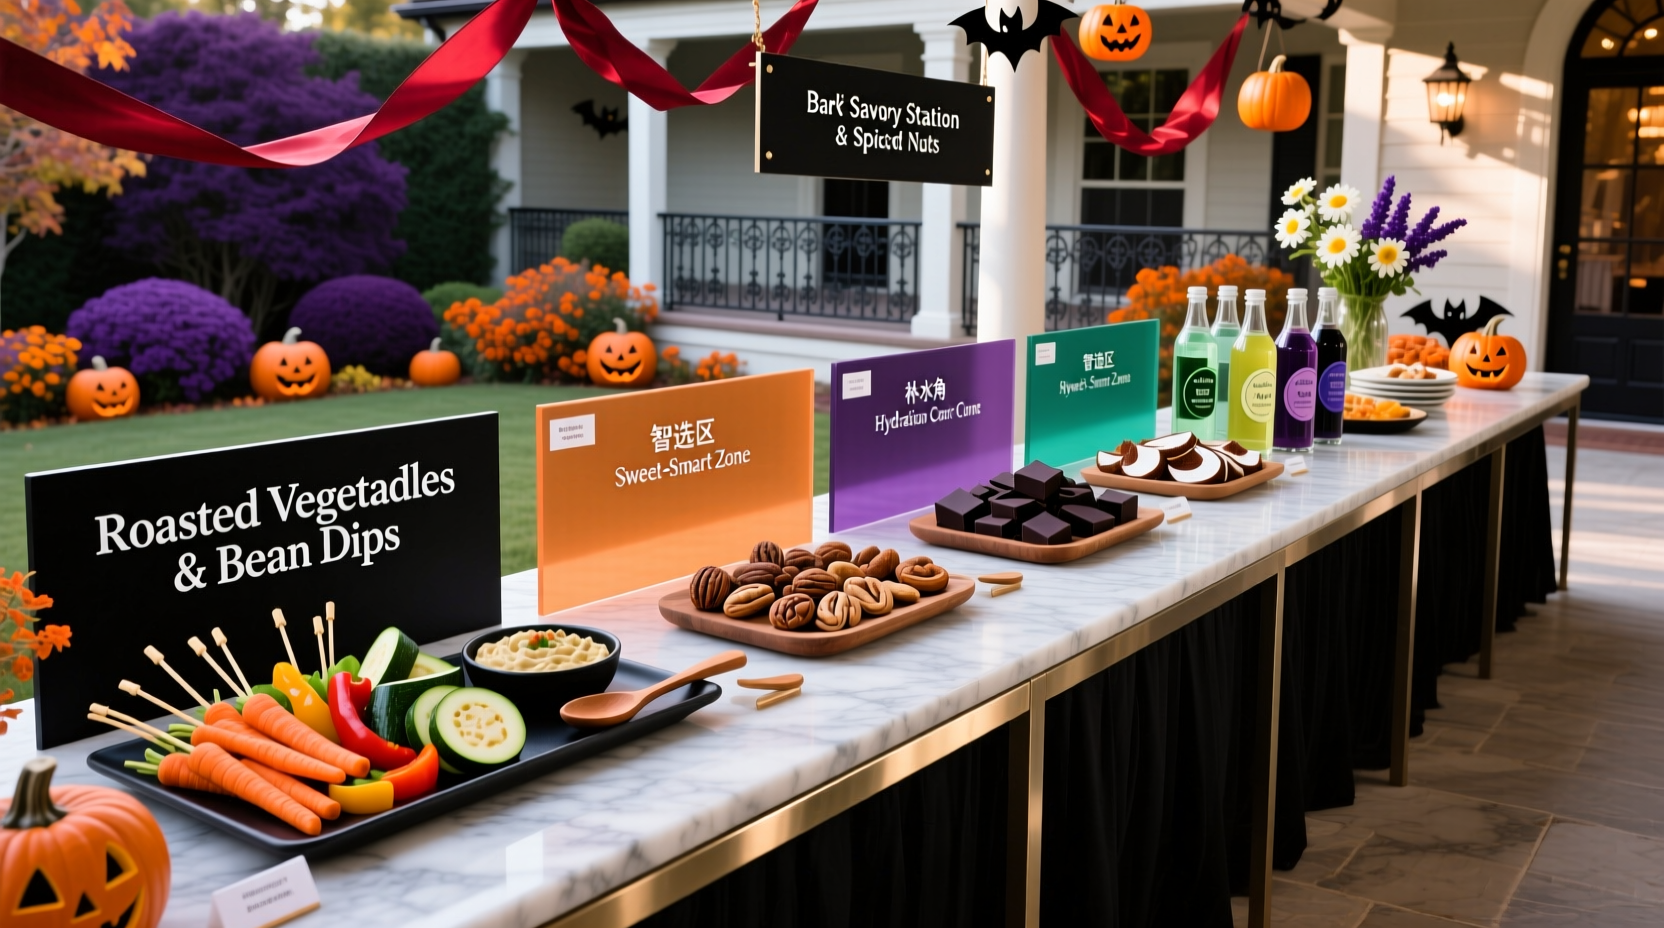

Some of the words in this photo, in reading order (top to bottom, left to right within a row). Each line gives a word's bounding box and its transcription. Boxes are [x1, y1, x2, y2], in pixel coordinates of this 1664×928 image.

[849, 95, 902, 129] Savory
[906, 102, 960, 129] Station
[835, 125, 848, 146] &
[908, 131, 940, 154] Nuts
[650, 418, 715, 453] 智选区
[615, 452, 712, 487] Sweet-Smart
[714, 448, 751, 469] Zone
[95, 488, 261, 555] Roasted
[267, 461, 455, 525] Vegetadles
[174, 552, 207, 592] &
[216, 540, 312, 585] Bean
[319, 522, 400, 566] Dips
